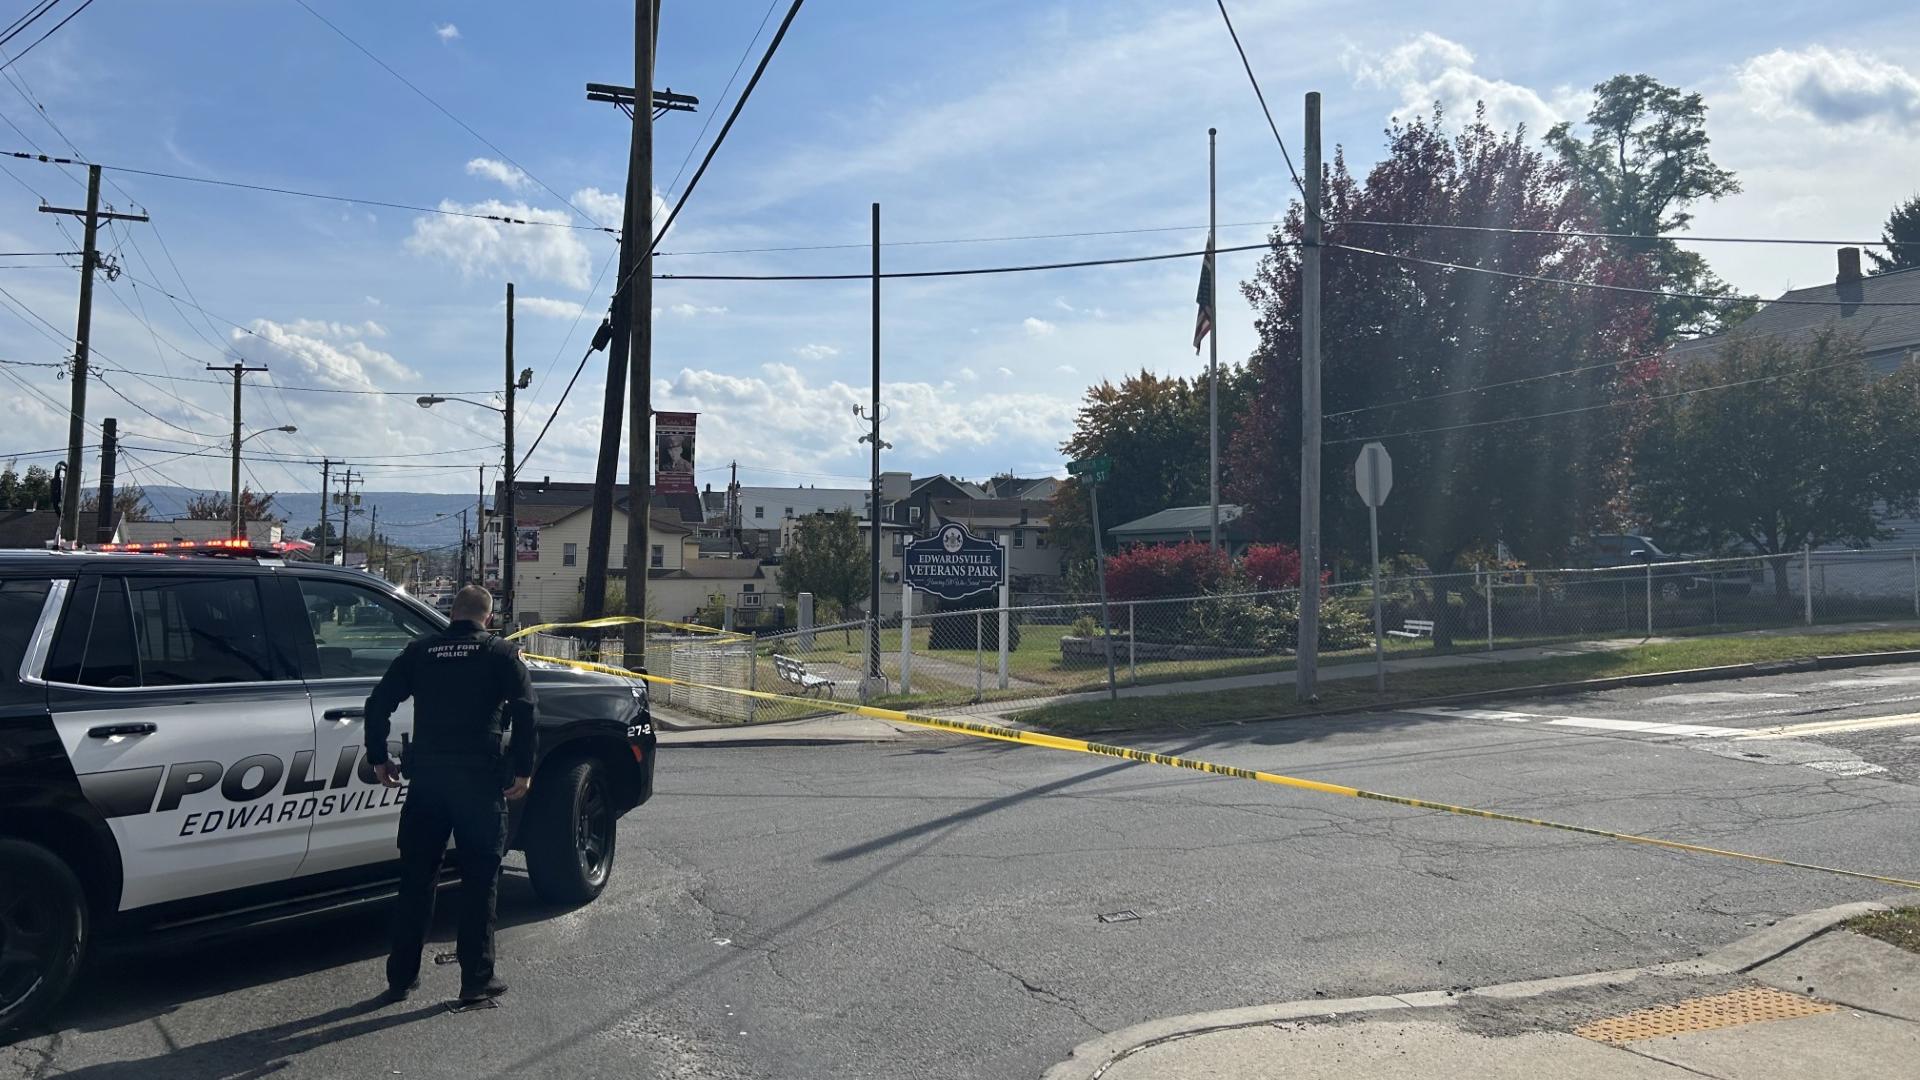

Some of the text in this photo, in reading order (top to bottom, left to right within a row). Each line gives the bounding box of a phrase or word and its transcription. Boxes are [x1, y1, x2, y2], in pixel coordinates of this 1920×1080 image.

[919, 554, 991, 564] EDWARDSVILLE
[909, 564, 998, 577] VETERANS PARK
[428, 645, 454, 653] FORTY
[179, 785, 409, 837] EDWARDSVILLE
